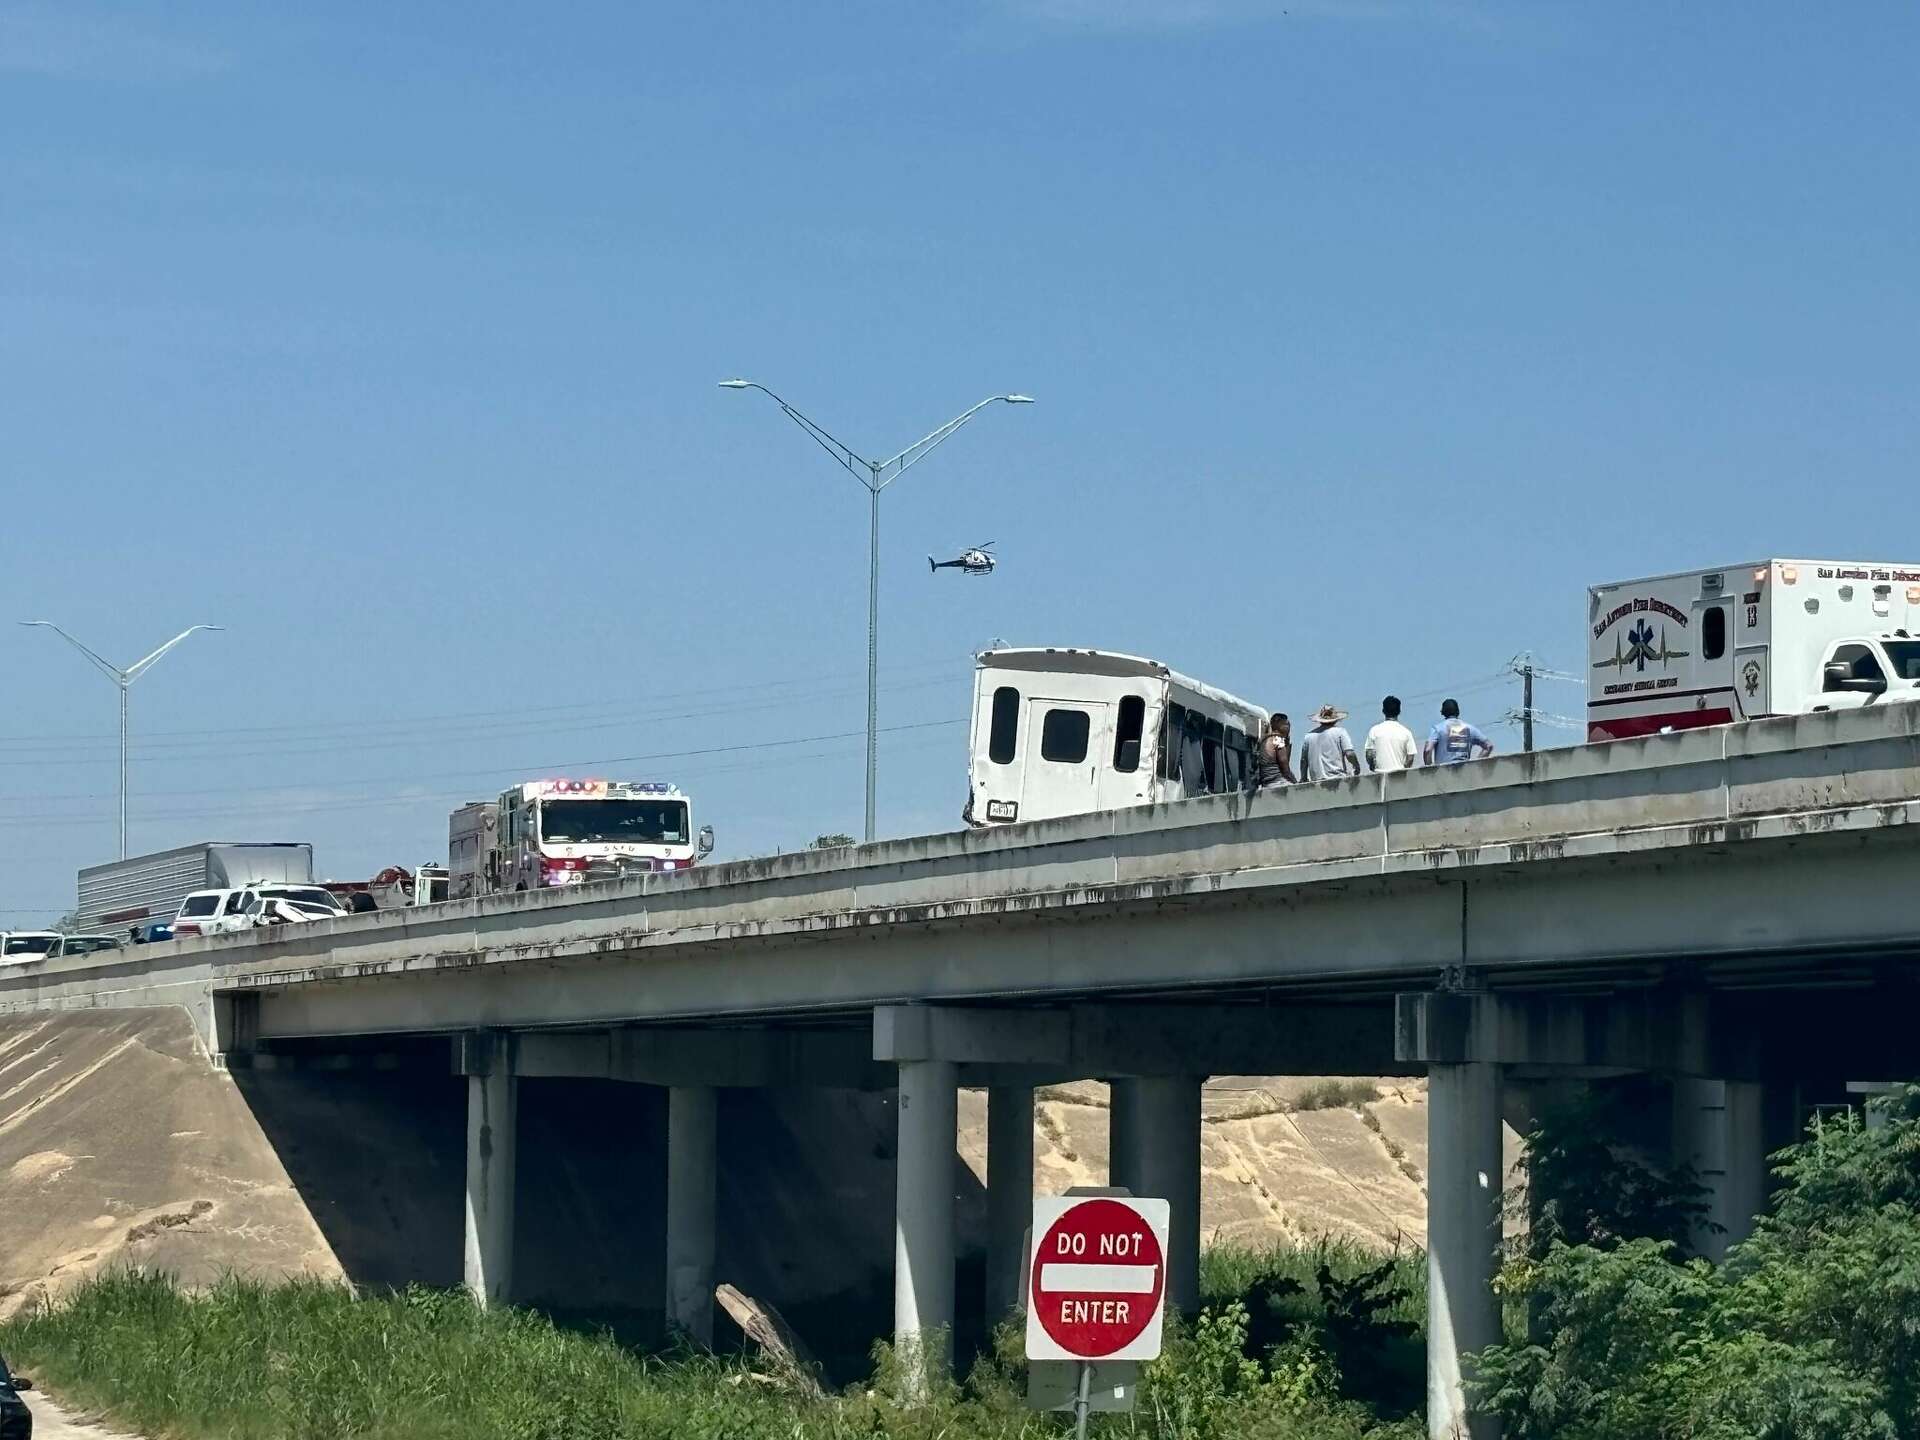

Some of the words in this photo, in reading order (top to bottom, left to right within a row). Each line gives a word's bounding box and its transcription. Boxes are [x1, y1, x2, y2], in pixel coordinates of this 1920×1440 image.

[1057, 1232, 1086, 1256] DO
[1100, 1231, 1143, 1257] NOT
[1061, 1300, 1130, 1324] ENTER
